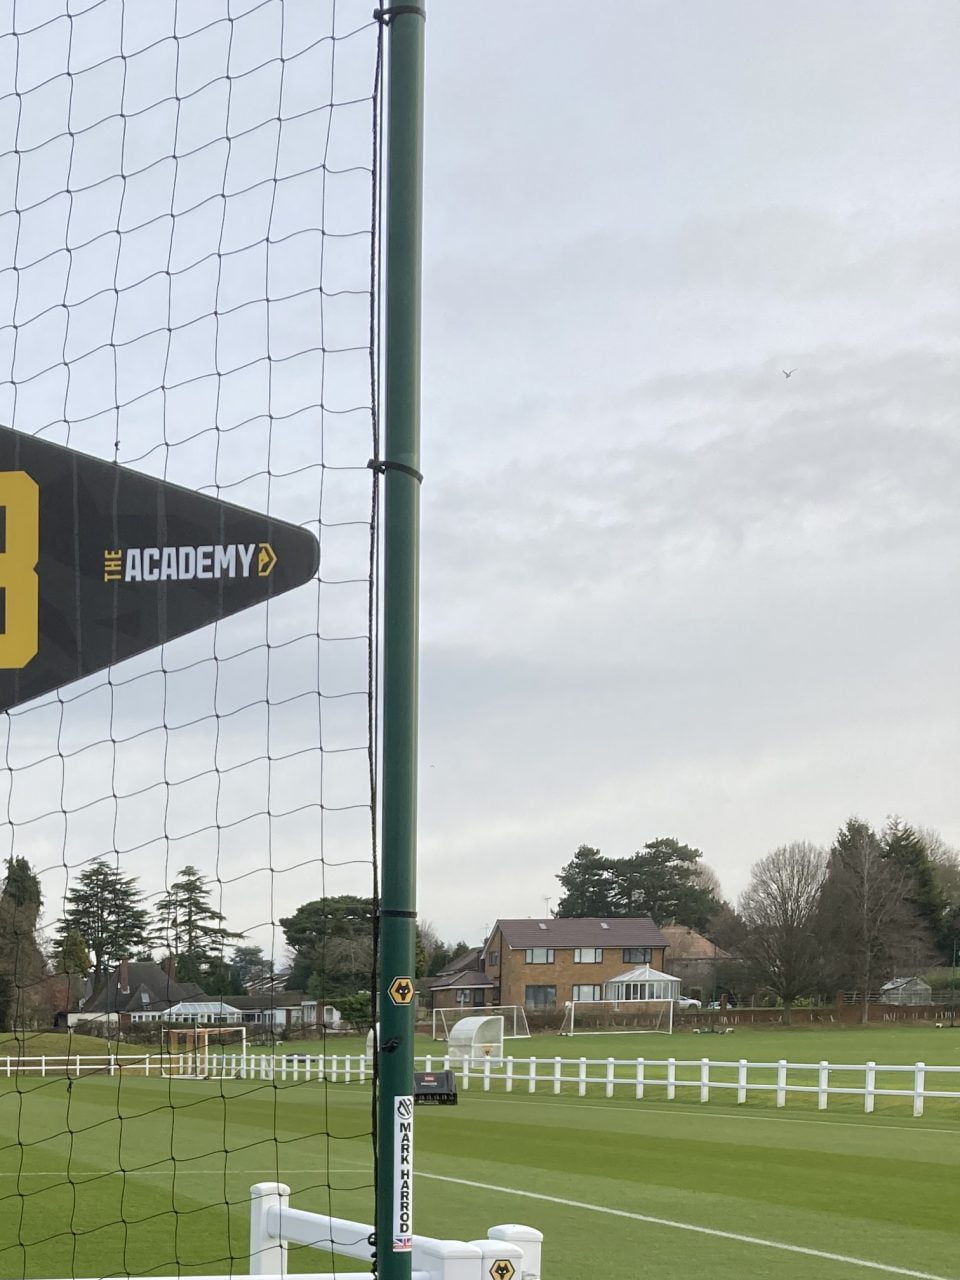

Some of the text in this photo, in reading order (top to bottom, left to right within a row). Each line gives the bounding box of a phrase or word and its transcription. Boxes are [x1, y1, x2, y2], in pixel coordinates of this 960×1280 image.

[104, 543, 256, 582] THE ACADEMY
[399, 1122, 411, 1165] MARK
[399, 1169, 410, 1233] HARROD
